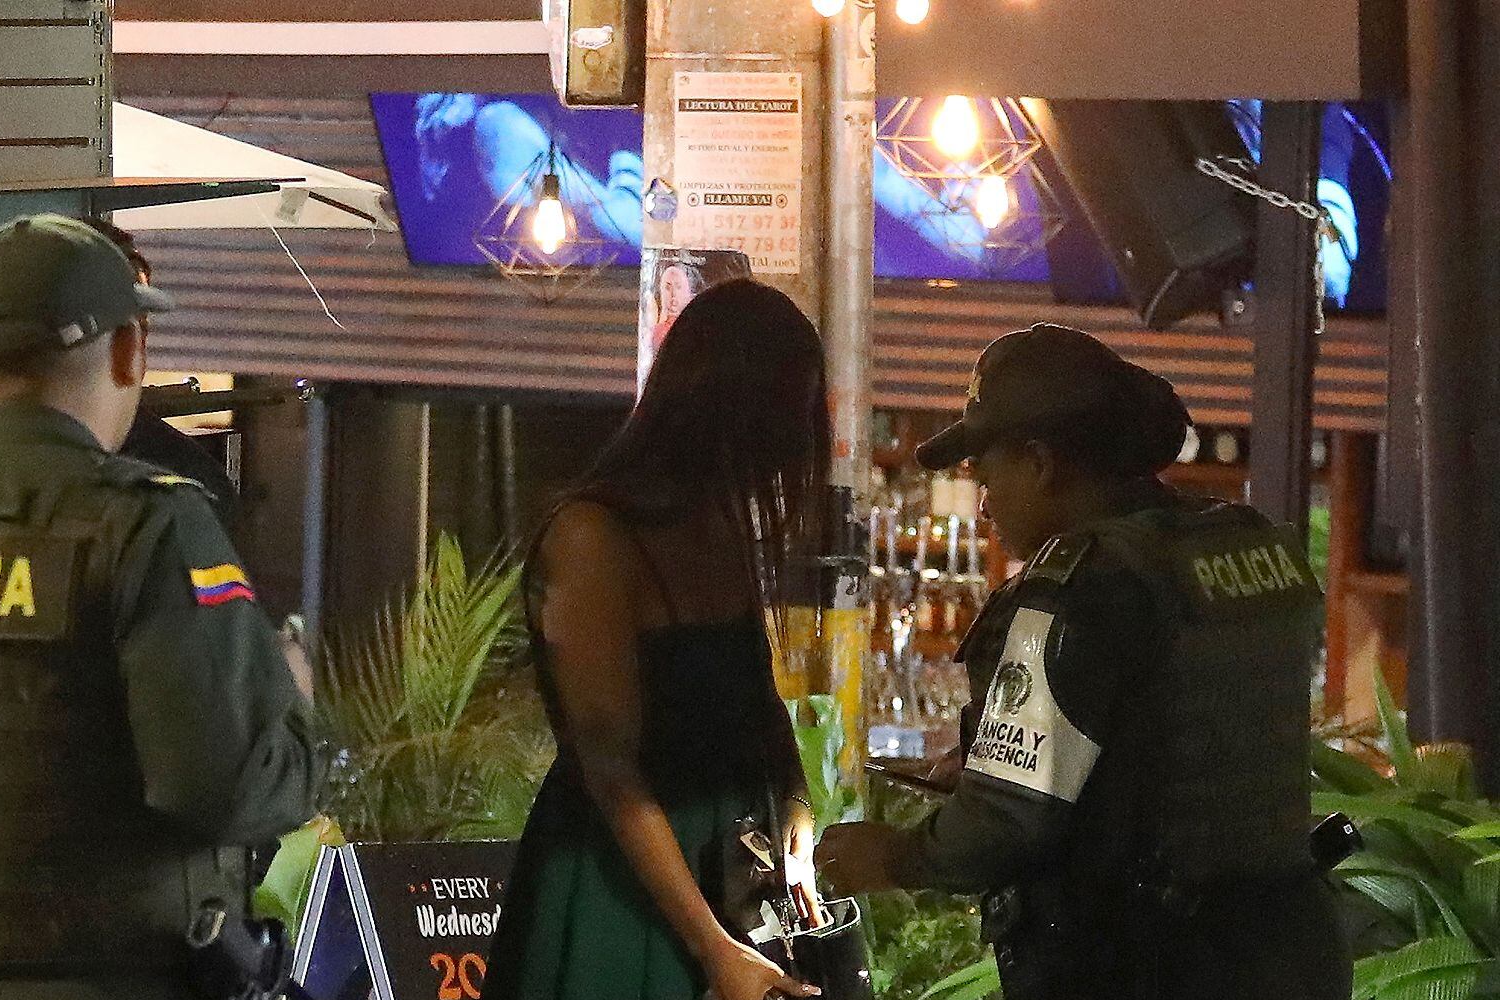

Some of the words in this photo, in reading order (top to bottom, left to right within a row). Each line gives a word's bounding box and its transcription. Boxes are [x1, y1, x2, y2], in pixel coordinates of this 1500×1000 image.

[685, 101, 736, 111] LECTURA
[737, 101, 760, 111] DEL
[1193, 543, 1303, 601] POLICIA
[1033, 731, 1047, 751] Y
[431, 877, 490, 899] EVERY
